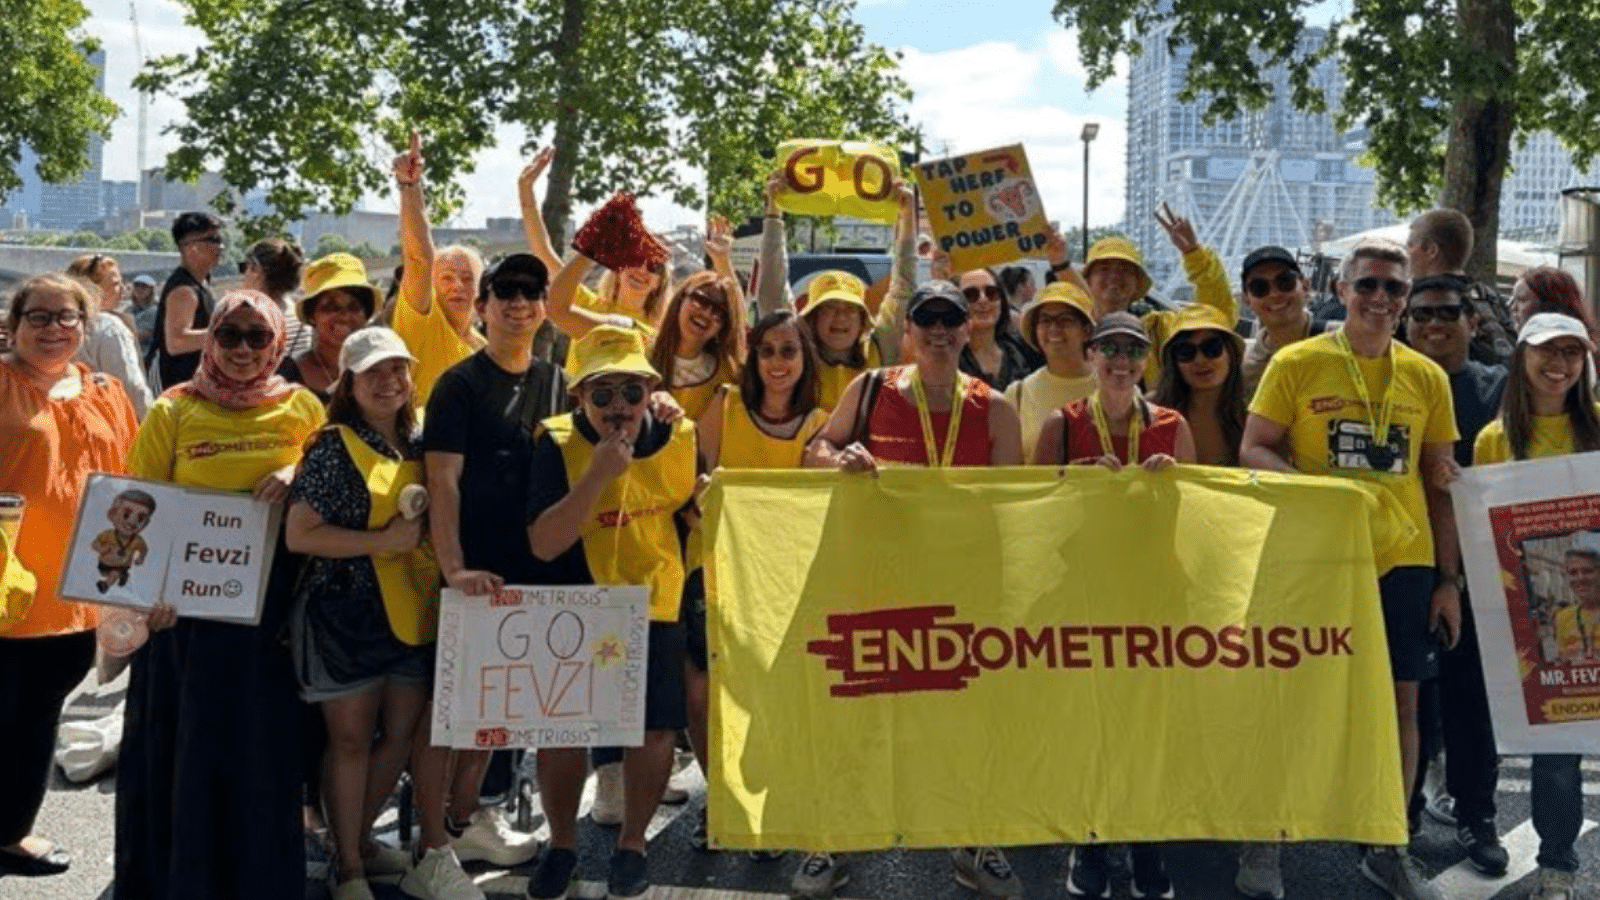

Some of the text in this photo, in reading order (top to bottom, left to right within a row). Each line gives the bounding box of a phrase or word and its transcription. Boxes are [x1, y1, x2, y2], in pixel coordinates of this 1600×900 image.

[785, 147, 892, 201] GO
[921, 156, 967, 181] TAP
[942, 199, 974, 221] TO
[940, 221, 1021, 252] POWER
[1017, 233, 1048, 253] UP
[203, 511, 242, 529] Run
[184, 542, 251, 566] Fevzi
[181, 579, 221, 597] Run
[497, 610, 584, 660] GO
[1539, 669, 1570, 686] MR.
[479, 661, 595, 720] FEVZI
